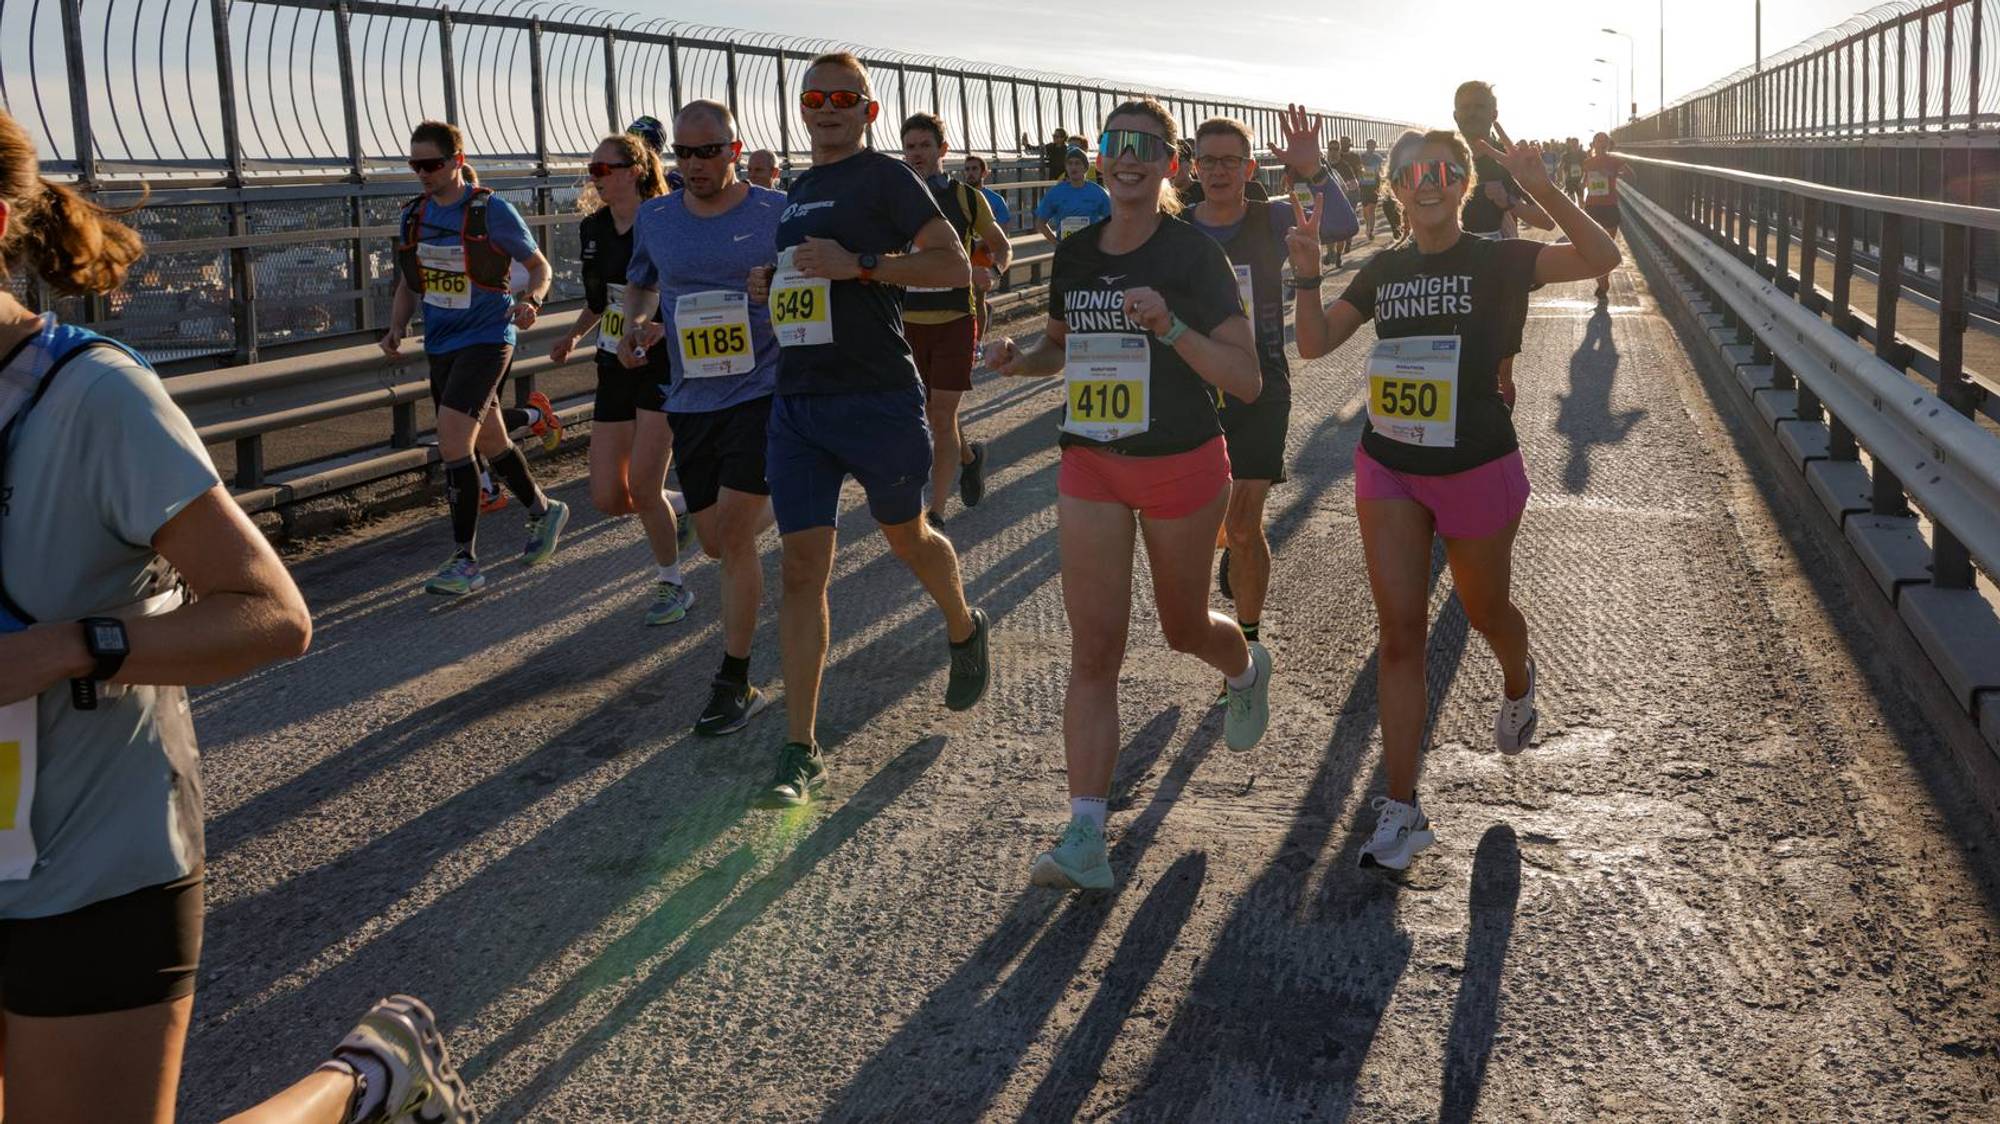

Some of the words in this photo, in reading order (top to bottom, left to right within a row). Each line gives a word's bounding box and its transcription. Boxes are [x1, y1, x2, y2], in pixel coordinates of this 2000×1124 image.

[1064, 290, 1125, 312] MIDNIG
[1375, 275, 1473, 304] MIDNIGHT
[776, 289, 814, 322] 549
[1375, 294, 1473, 323] RUNNERS
[686, 326, 744, 356] 1185
[1077, 384, 1130, 419] 410
[1382, 381, 1437, 417] 550
